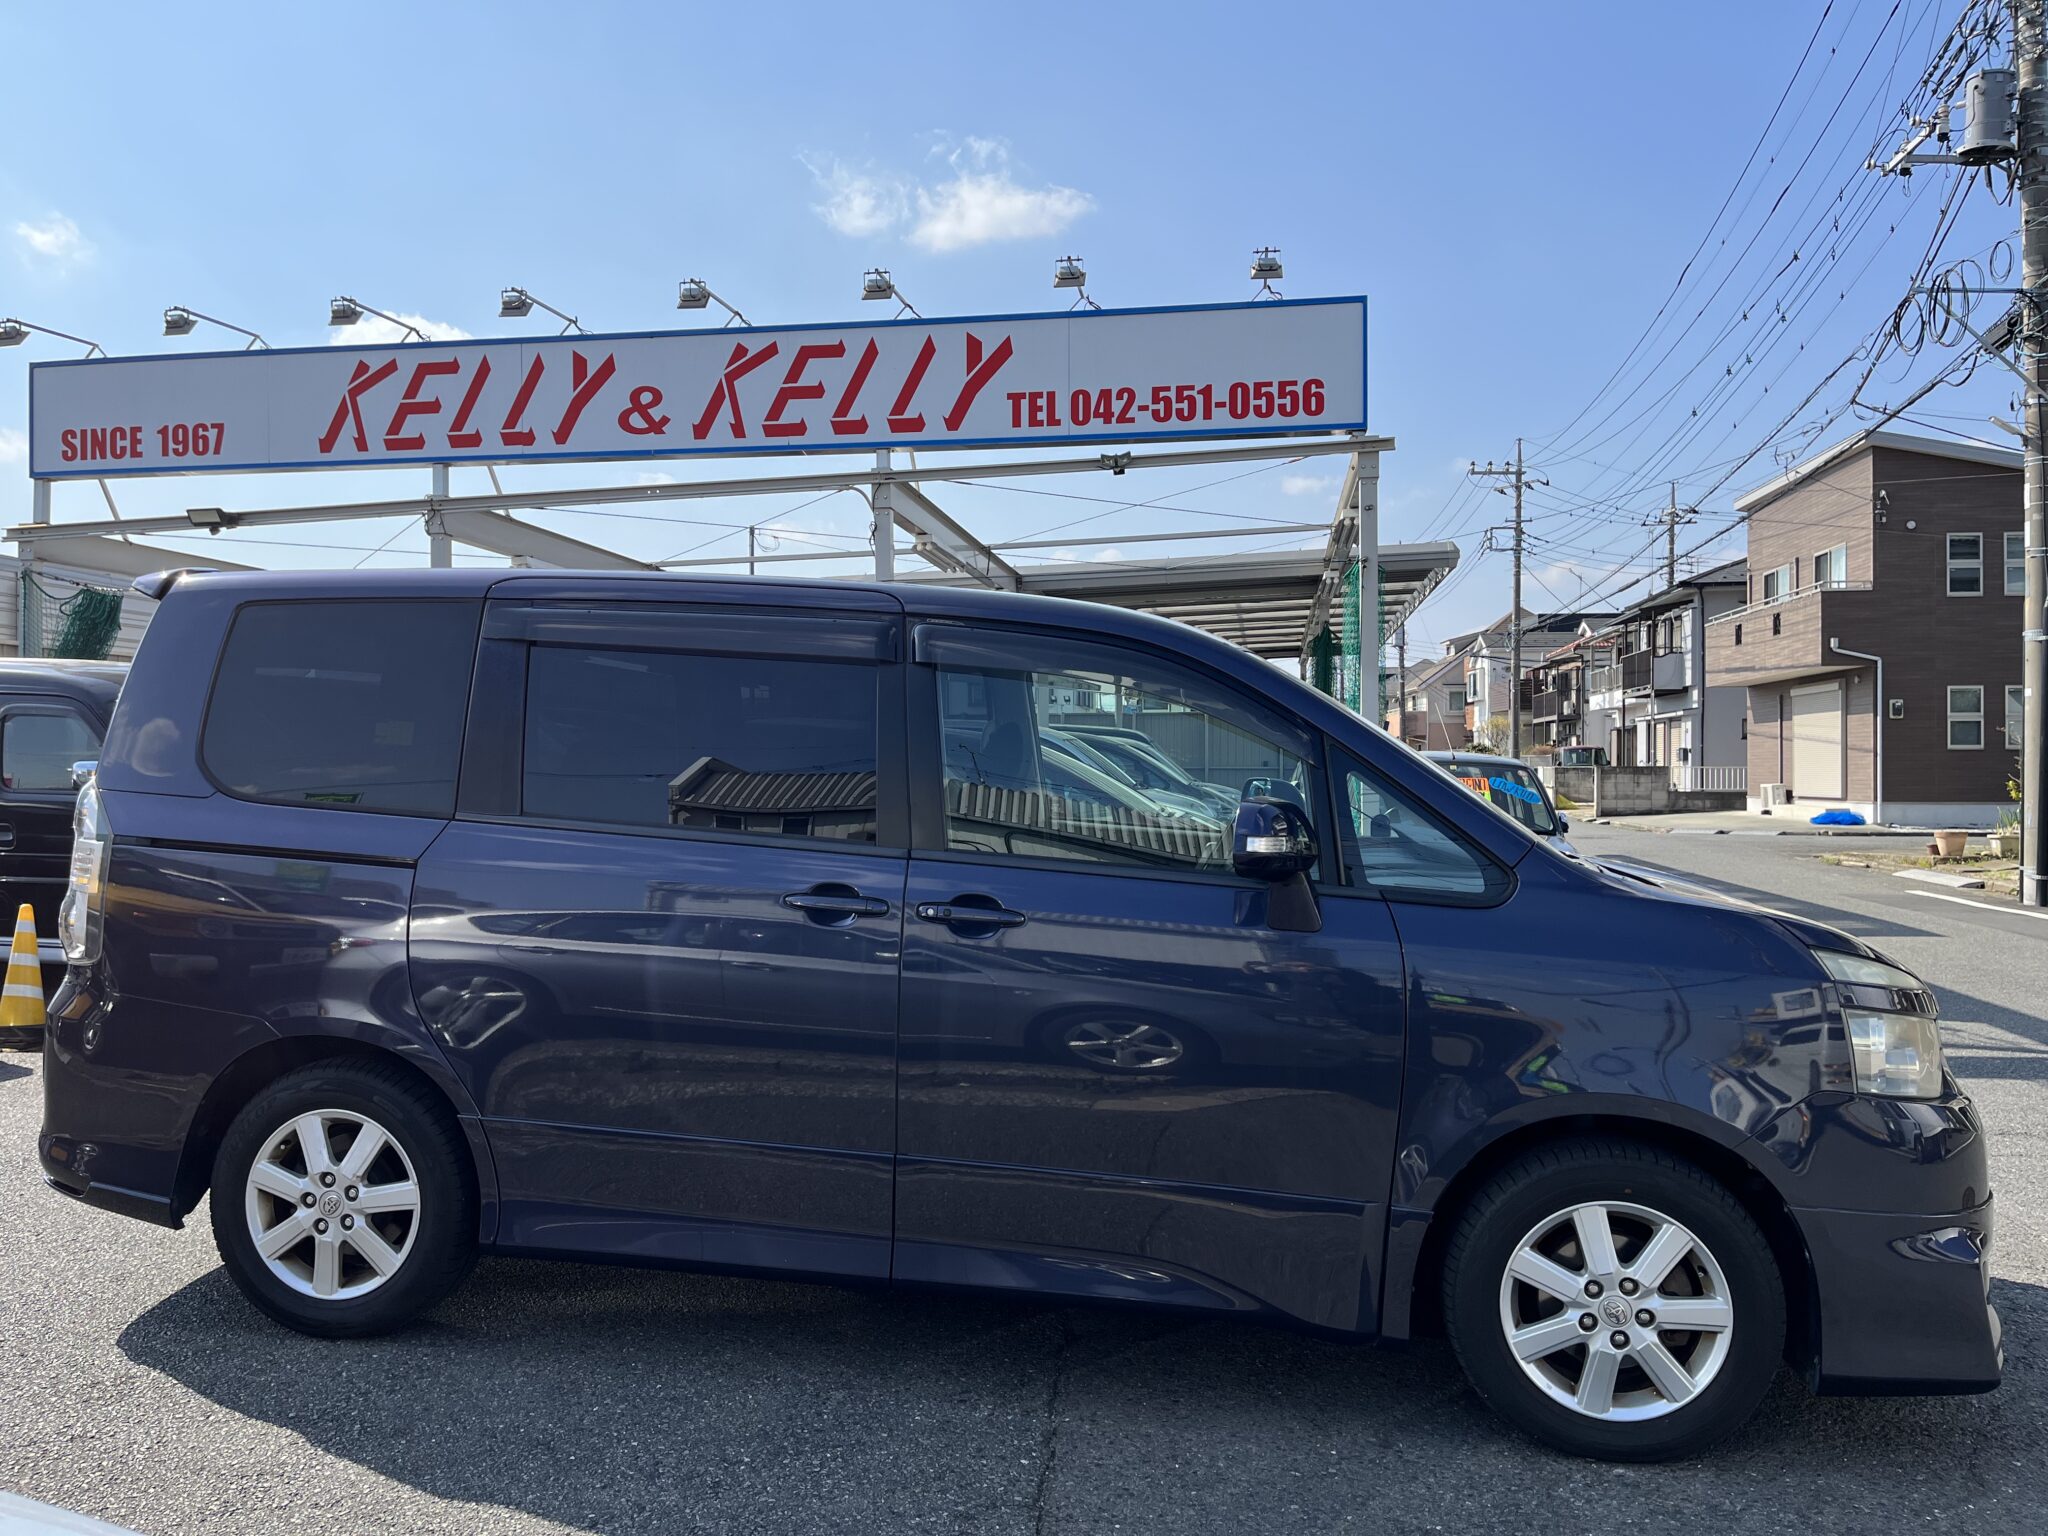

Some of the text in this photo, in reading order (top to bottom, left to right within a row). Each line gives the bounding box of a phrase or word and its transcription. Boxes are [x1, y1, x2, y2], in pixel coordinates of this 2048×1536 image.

[319, 332, 1014, 453] KELLY & KELLY
[1007, 378, 1326, 429] TEL 042-551-0556
[61, 422, 226, 462] SINCE 1967
